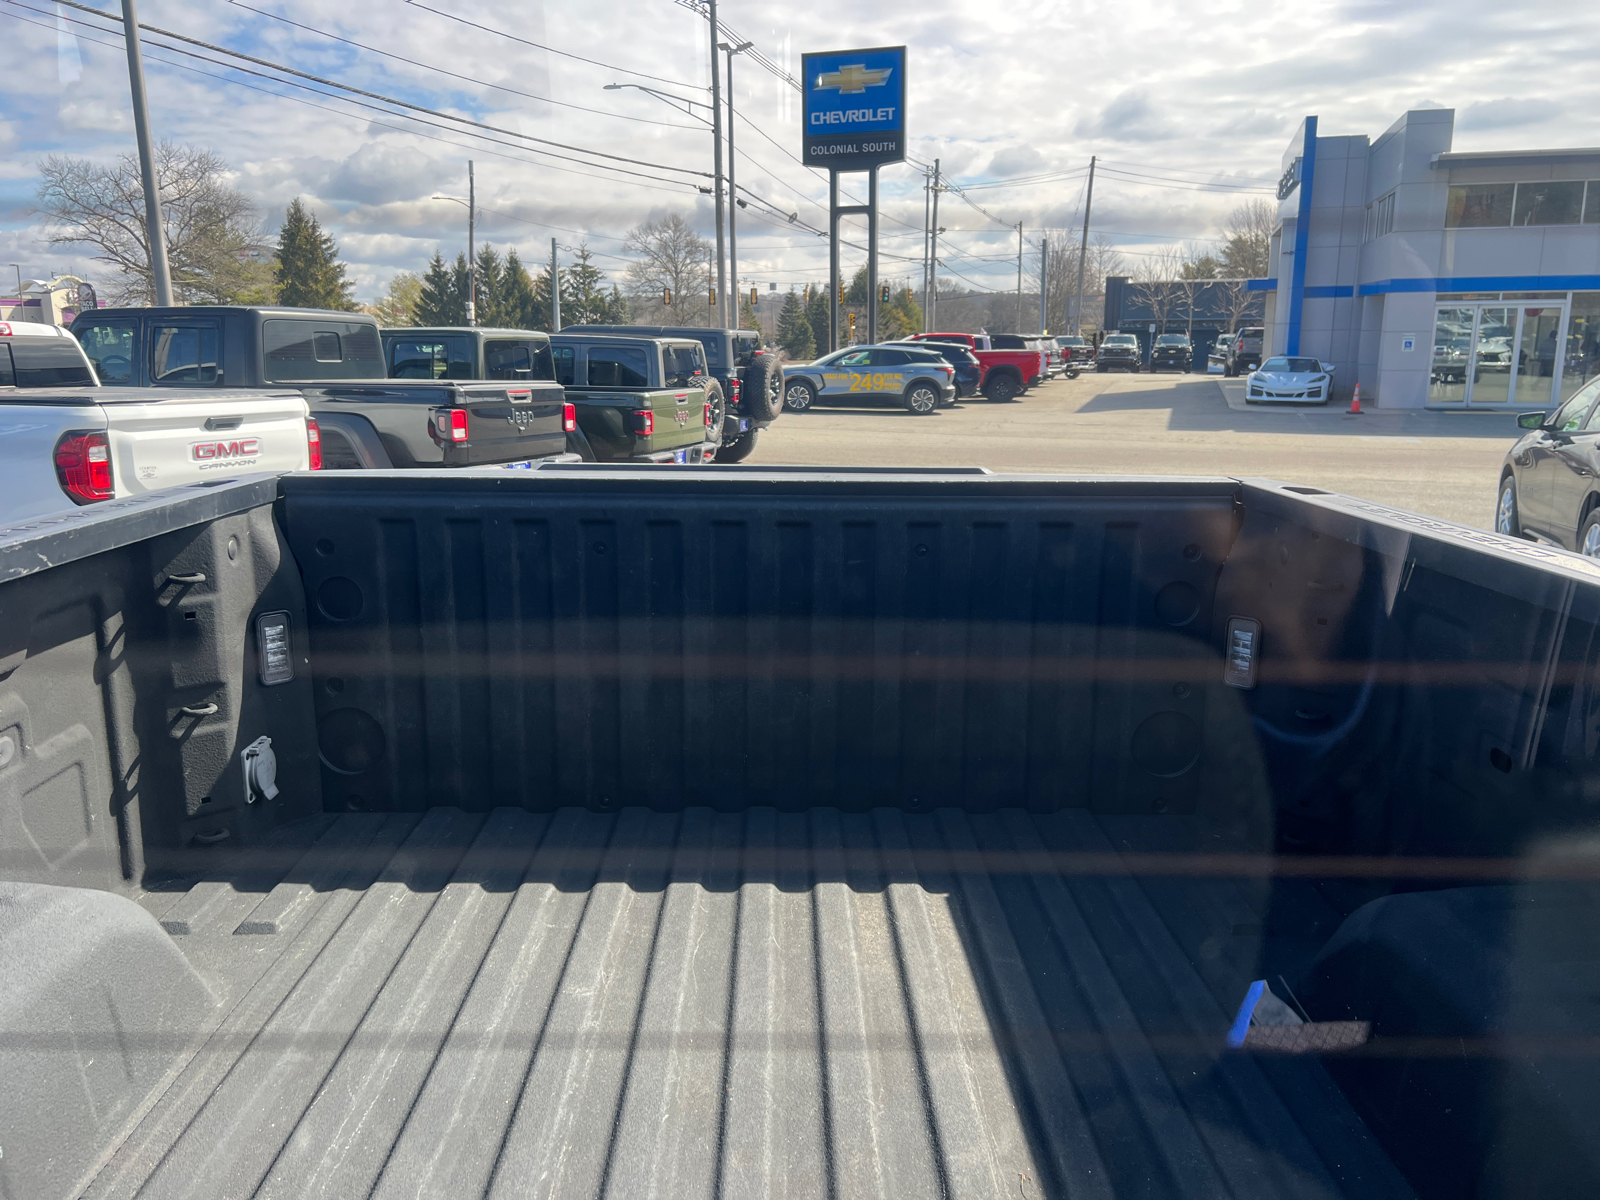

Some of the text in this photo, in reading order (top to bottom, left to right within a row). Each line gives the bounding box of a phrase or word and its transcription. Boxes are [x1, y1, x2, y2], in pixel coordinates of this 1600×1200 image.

[811, 107, 895, 125] CHEVROLET
[810, 141, 896, 155] COLONIAL SOUTH
[507, 408, 534, 427] Jeep
[673, 408, 689, 423] Jeep
[193, 440, 259, 461] GMC
[199, 459, 257, 471] CANYON
